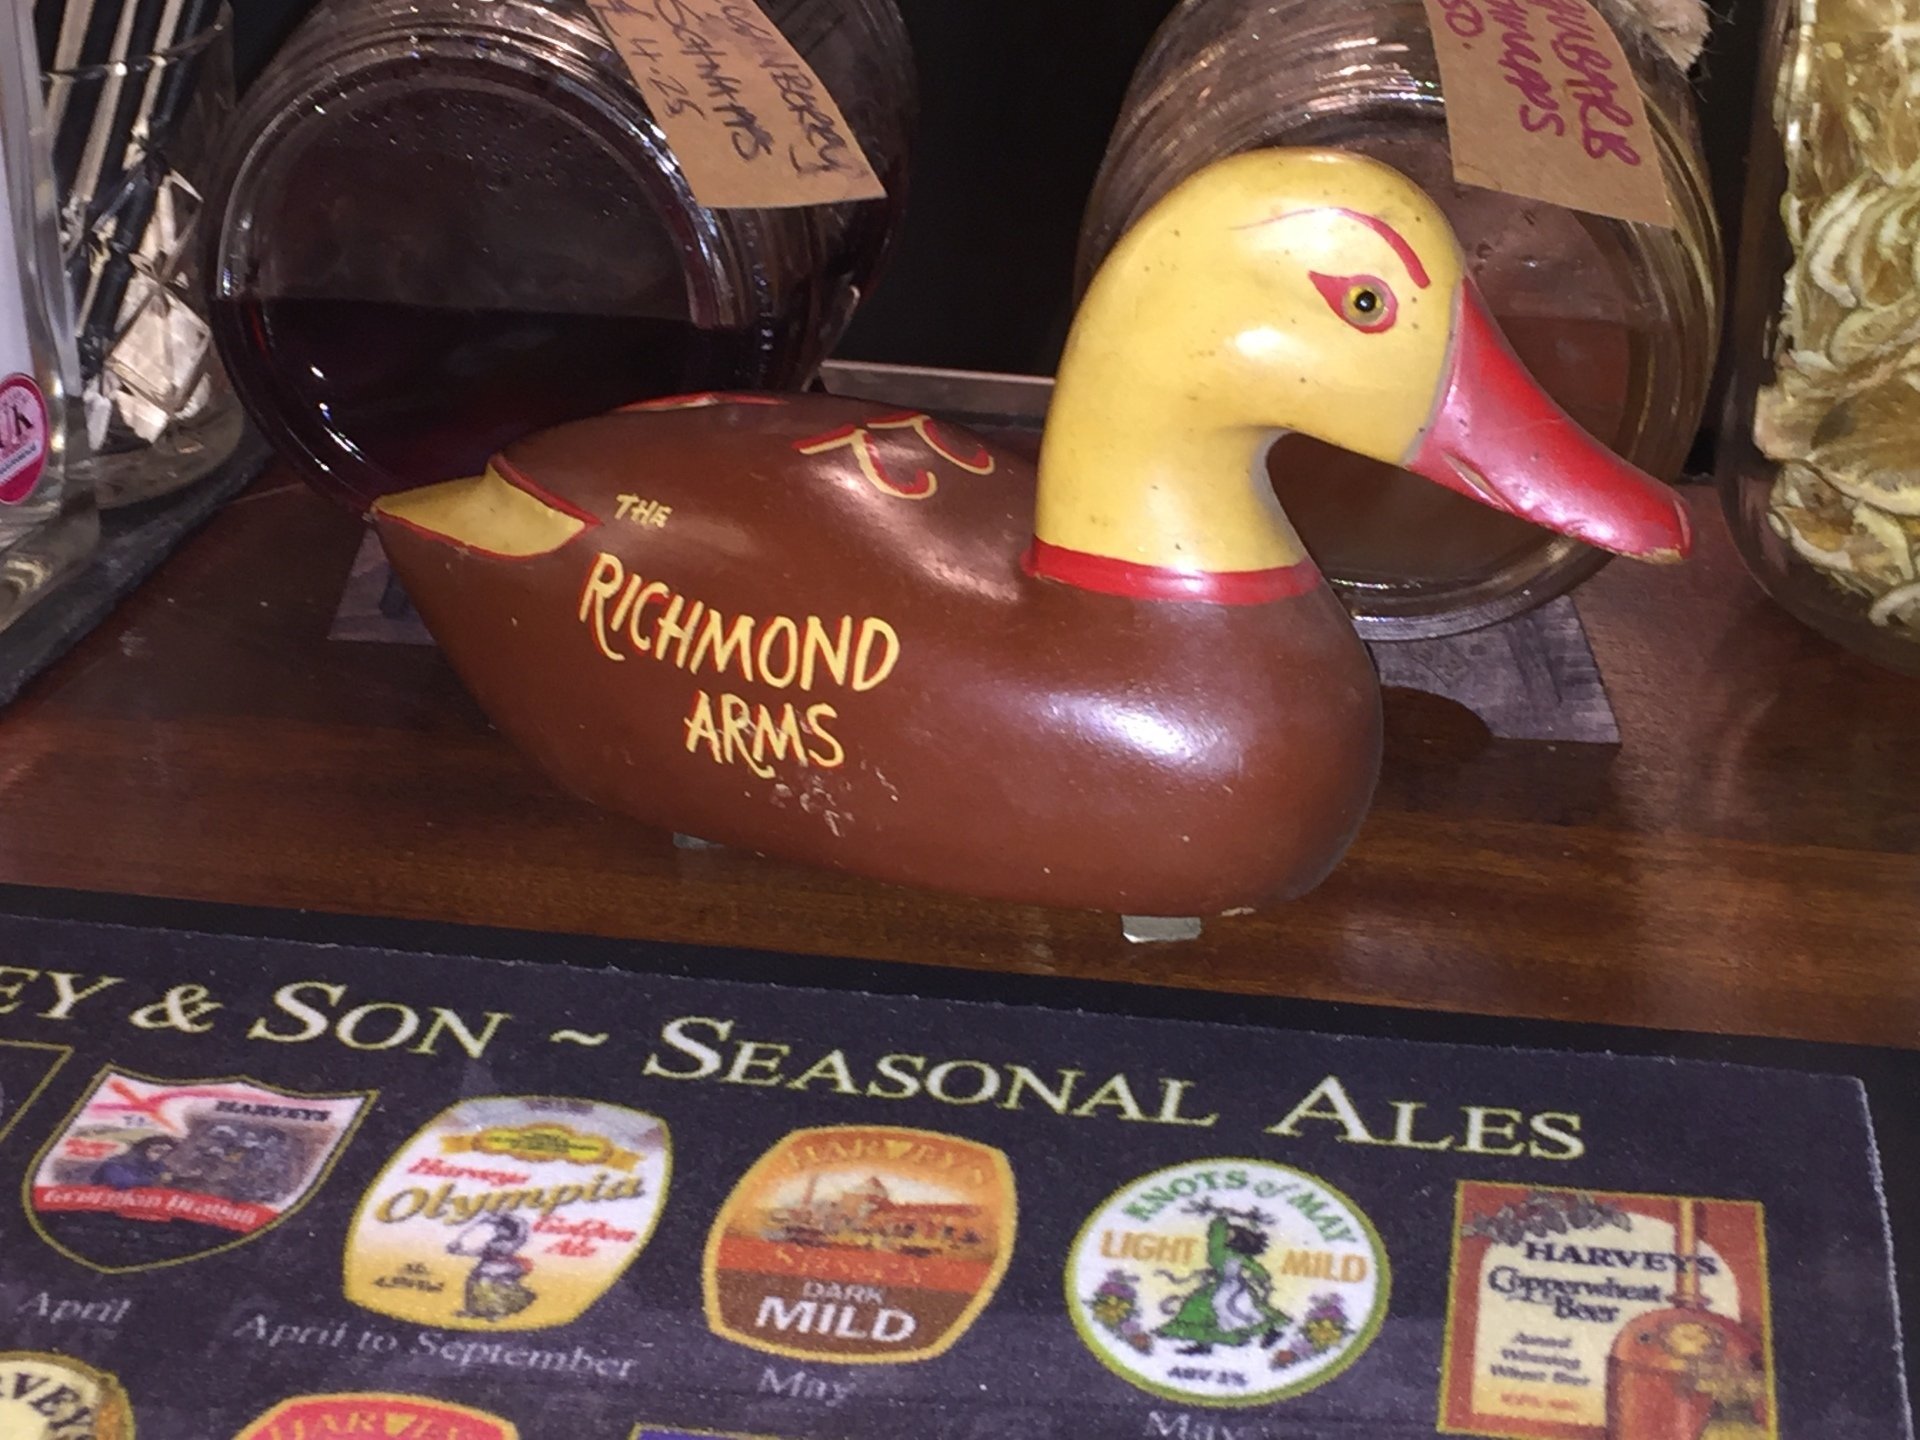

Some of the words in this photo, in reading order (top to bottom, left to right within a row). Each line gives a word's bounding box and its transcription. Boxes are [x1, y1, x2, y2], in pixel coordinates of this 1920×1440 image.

[615, 493, 672, 528] THE
[578, 551, 900, 692] RICHMOND
[683, 690, 845, 778] ARMS
[129, 984, 223, 1033] &
[642, 1016, 1220, 1128] SEASONAL
[1264, 1075, 1586, 1160] ALES
[374, 1172, 646, 1226] Olympia
[1120, 1169, 1248, 1222] KNOTS
[1286, 1191, 1357, 1244] MAY
[1099, 1230, 1199, 1266] LIGHT
[1280, 1249, 1368, 1284] MILD
[1523, 1241, 1718, 1276] HARVEYS
[15, 1291, 132, 1324] April
[802, 1280, 884, 1304] DARK
[755, 1295, 917, 1342] MILD
[233, 1313, 348, 1347] April
[410, 1331, 640, 1379] September
